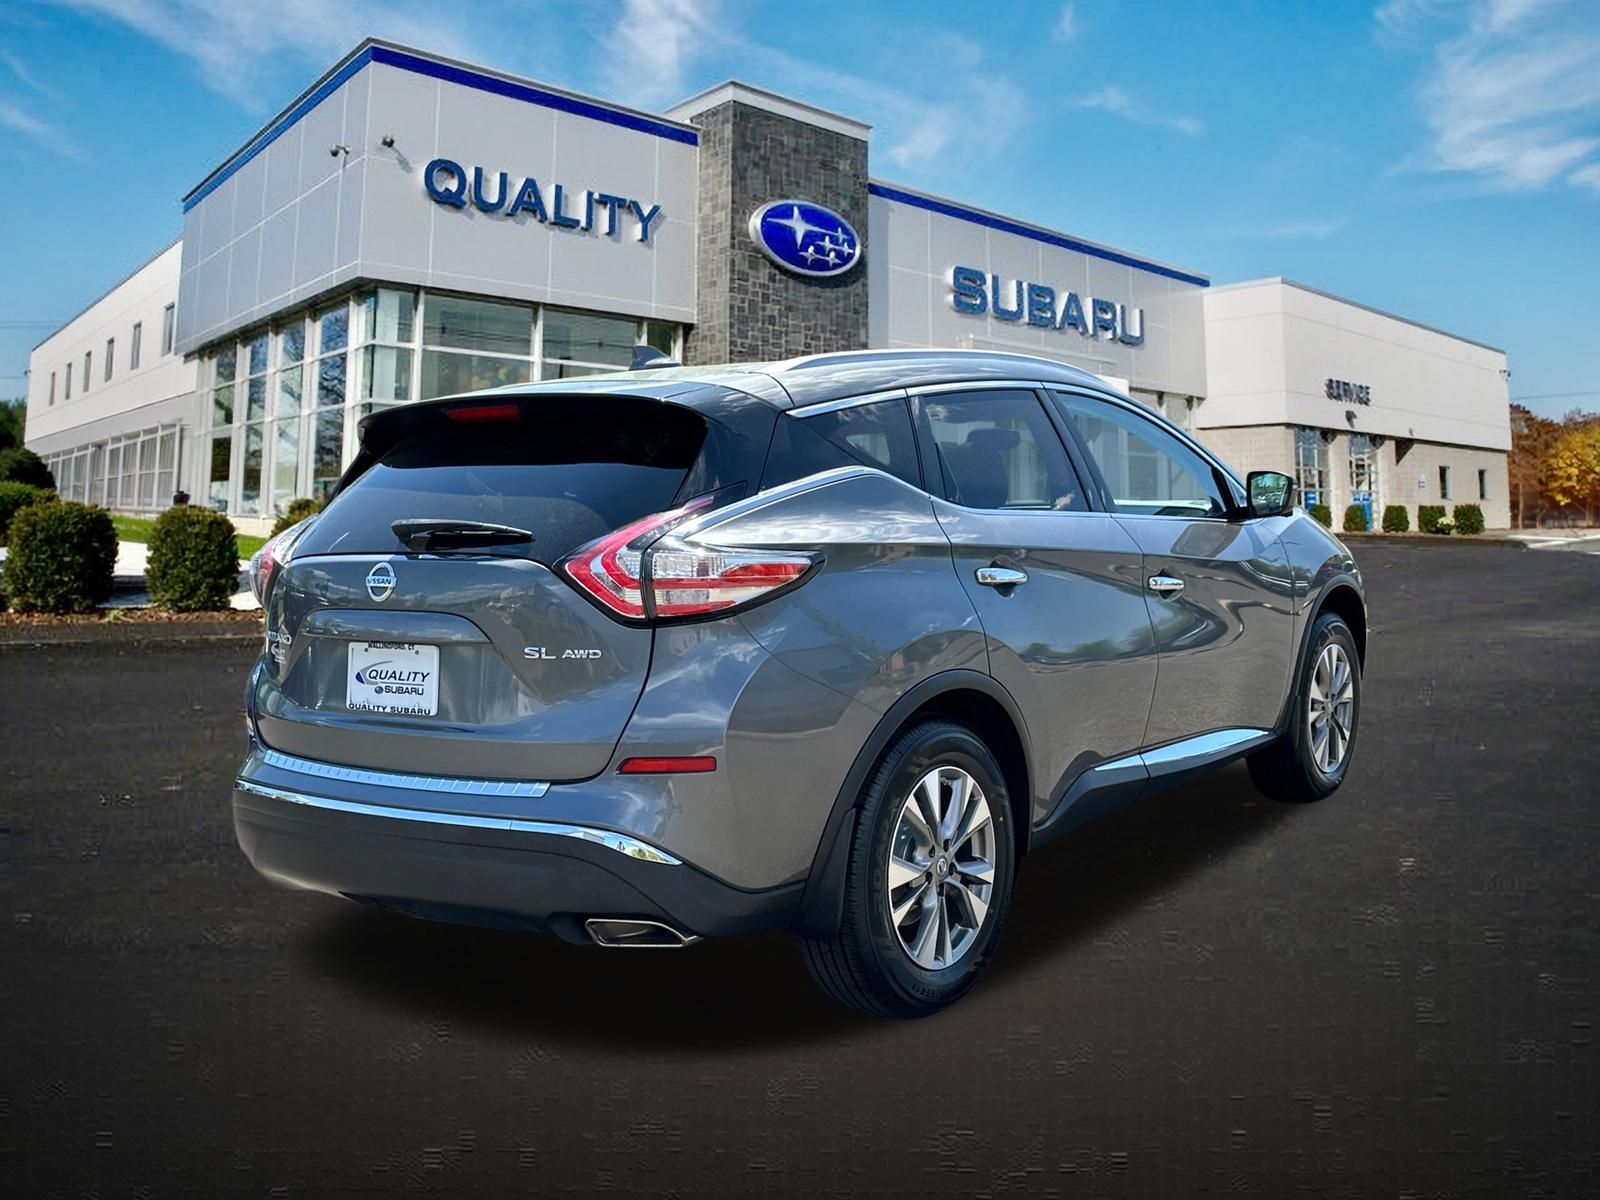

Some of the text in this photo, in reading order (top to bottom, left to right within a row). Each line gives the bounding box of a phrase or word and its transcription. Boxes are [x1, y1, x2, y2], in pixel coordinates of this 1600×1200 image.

[424, 158, 661, 243] QUALITY
[953, 266, 1145, 346] SUBARU
[1326, 378, 1371, 406] SERVICE
[367, 577, 392, 585] NISSAN
[523, 646, 602, 660] SL AWD
[368, 669, 430, 683] QUALITY
[384, 686, 424, 696] SUBARU
[348, 702, 431, 716] QUALITY SUBARU
